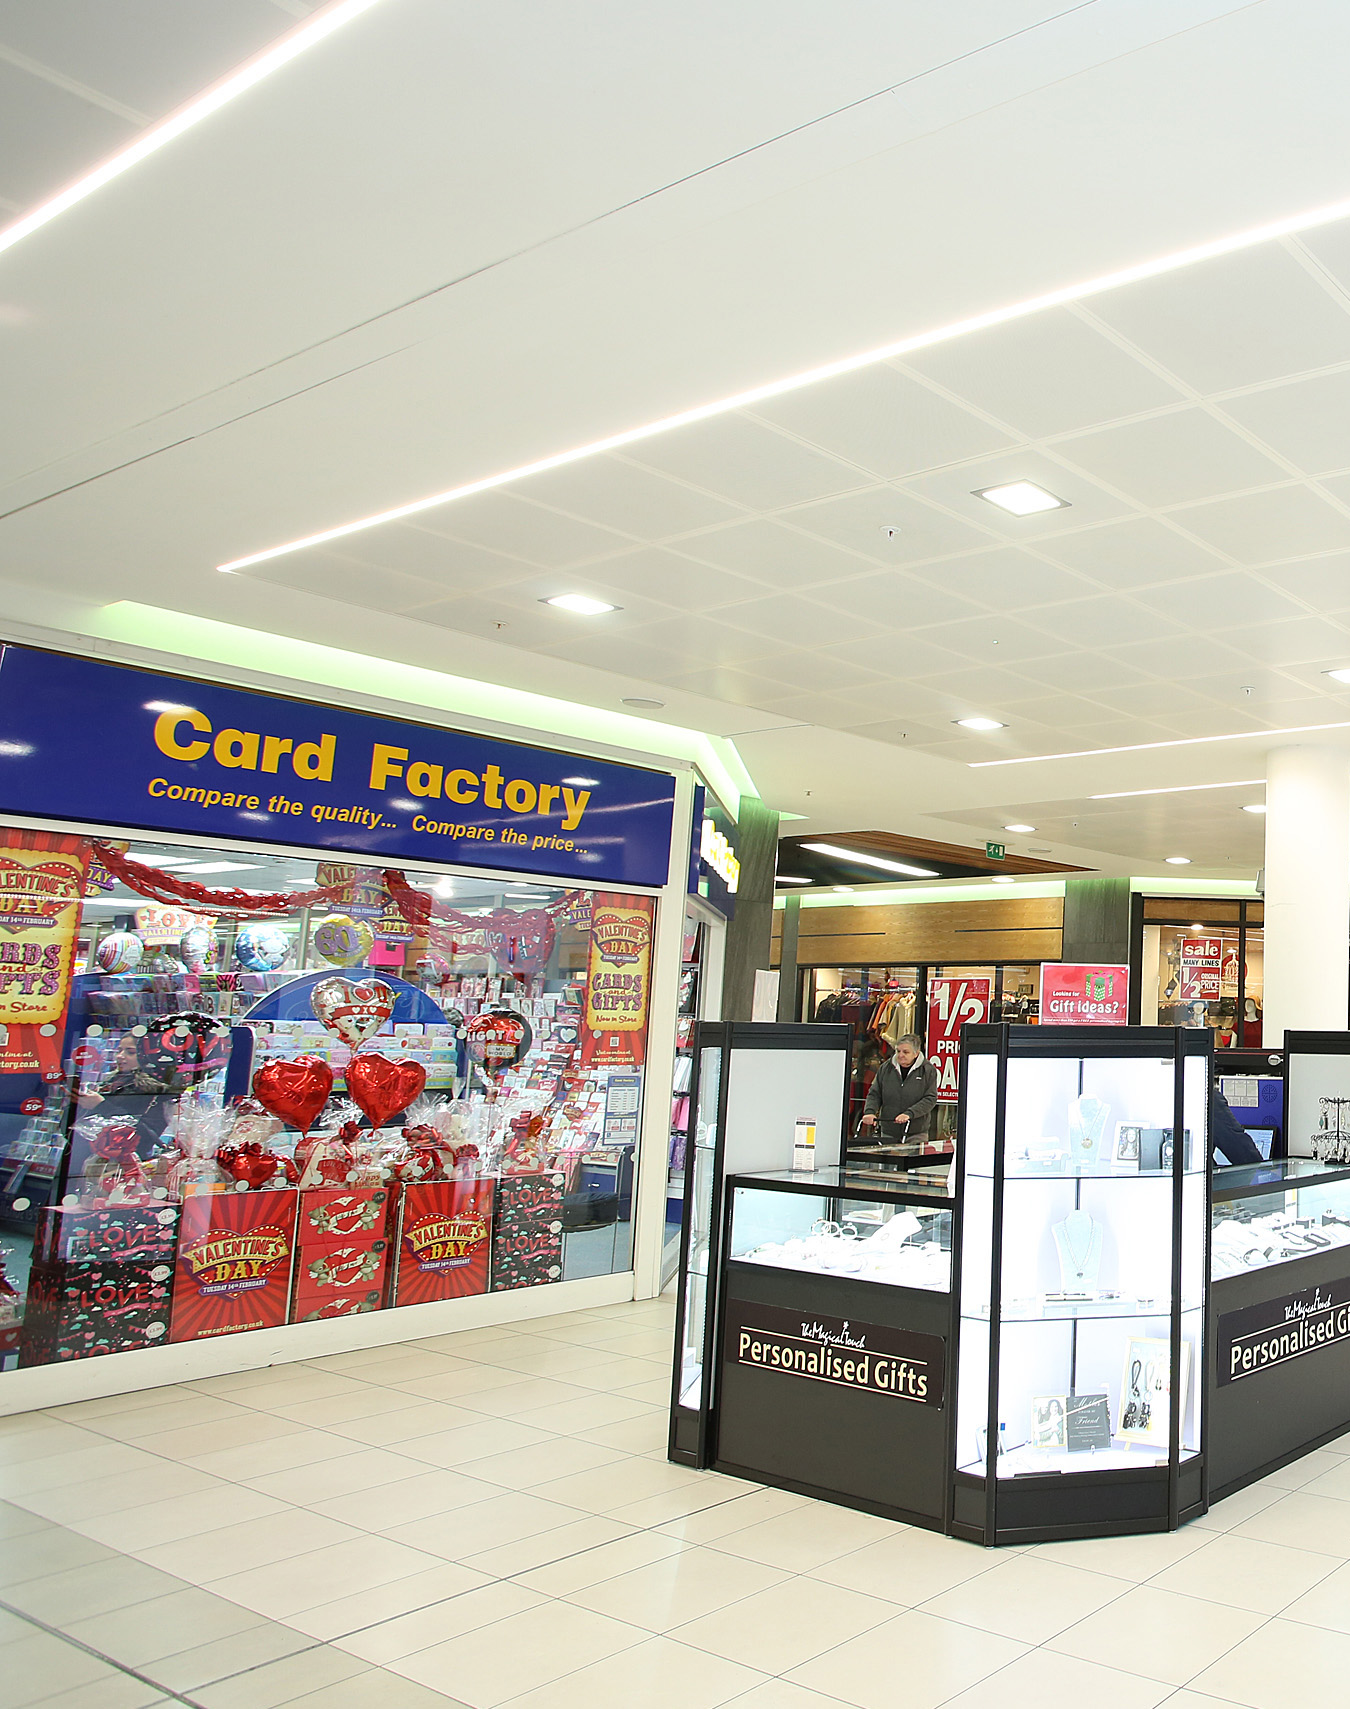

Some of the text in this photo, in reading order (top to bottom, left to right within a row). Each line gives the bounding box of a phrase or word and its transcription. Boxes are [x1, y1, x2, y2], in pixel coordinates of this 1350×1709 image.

[153, 706, 592, 832] Card Factory
[147, 777, 588, 854] Compare the quality... Compare the price...
[0, 897, 48, 915] DAY
[22, 917, 55, 926] FEBRUARY
[382, 920, 411, 934] DAY
[609, 941, 636, 954] DAY
[1184, 940, 1219, 957] sale
[1201, 959, 1220, 967] LINES
[592, 972, 643, 993] CARDS
[1182, 967, 1202, 998] 1/2
[1200, 980, 1220, 990] PRICE
[10, 1001, 48, 1013] Store
[592, 991, 644, 1011] GIFTS
[1049, 999, 1119, 1014] Gift ideas?
[595, 1014, 611, 1023] Now
[618, 1014, 637, 1024] Store
[936, 1040, 960, 1054] PRI
[930, 1055, 959, 1090] SA
[510, 1187, 552, 1206] LOVE
[89, 1224, 158, 1249] LOVE
[505, 1233, 549, 1253] LOVE
[429, 1240, 468, 1260] DAY
[213, 1260, 264, 1282] DAY
[421, 1262, 441, 1270] TUESDAY
[449, 1258, 471, 1267] FEBRUARY
[80, 1281, 150, 1309] LOVE
[203, 1284, 228, 1293] TUESDAY
[239, 1279, 267, 1289] FEBRUARY
[197, 1319, 265, 1336] www.cardfactory.co.uk
[1230, 1311, 1335, 1375] Personalised
[738, 1332, 928, 1397] Personalised Gifts
